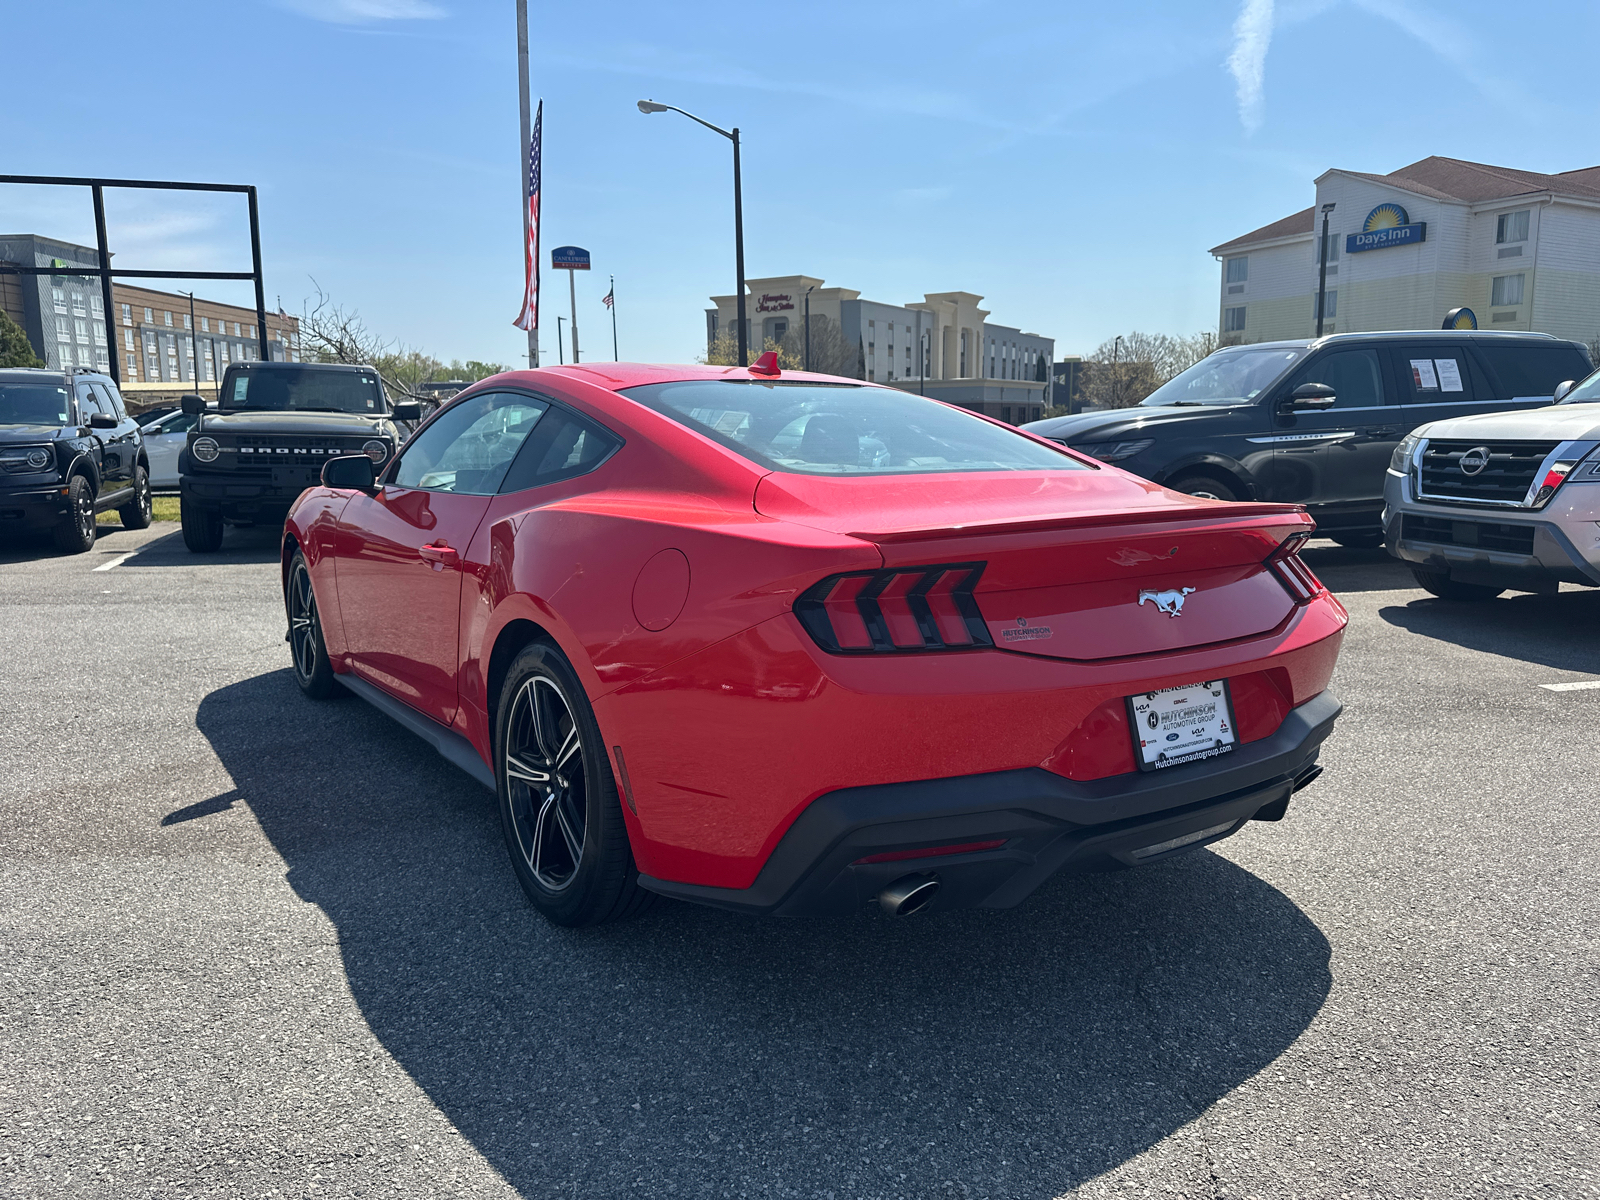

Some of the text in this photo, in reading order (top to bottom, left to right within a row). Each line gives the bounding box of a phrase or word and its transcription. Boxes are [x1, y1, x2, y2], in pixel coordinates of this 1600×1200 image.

[1356, 228, 1410, 245] Days Inn
[1373, 240, 1400, 248] WYNDHAM
[758, 293, 792, 304] Hampton
[240, 447, 342, 455] BRONCO
[1002, 627, 1051, 637] HUTCHINSON
[1136, 703, 1150, 712] KIA
[1161, 702, 1216, 724] HUTCHINSON
[1163, 714, 1216, 731] AUTOMOTIVE GROUP
[1191, 727, 1205, 735] KIA
[1163, 737, 1213, 752] HUTCHINSONAUTOGROUP.COM
[1155, 744, 1232, 769] Hutchinsonautogroup.com
